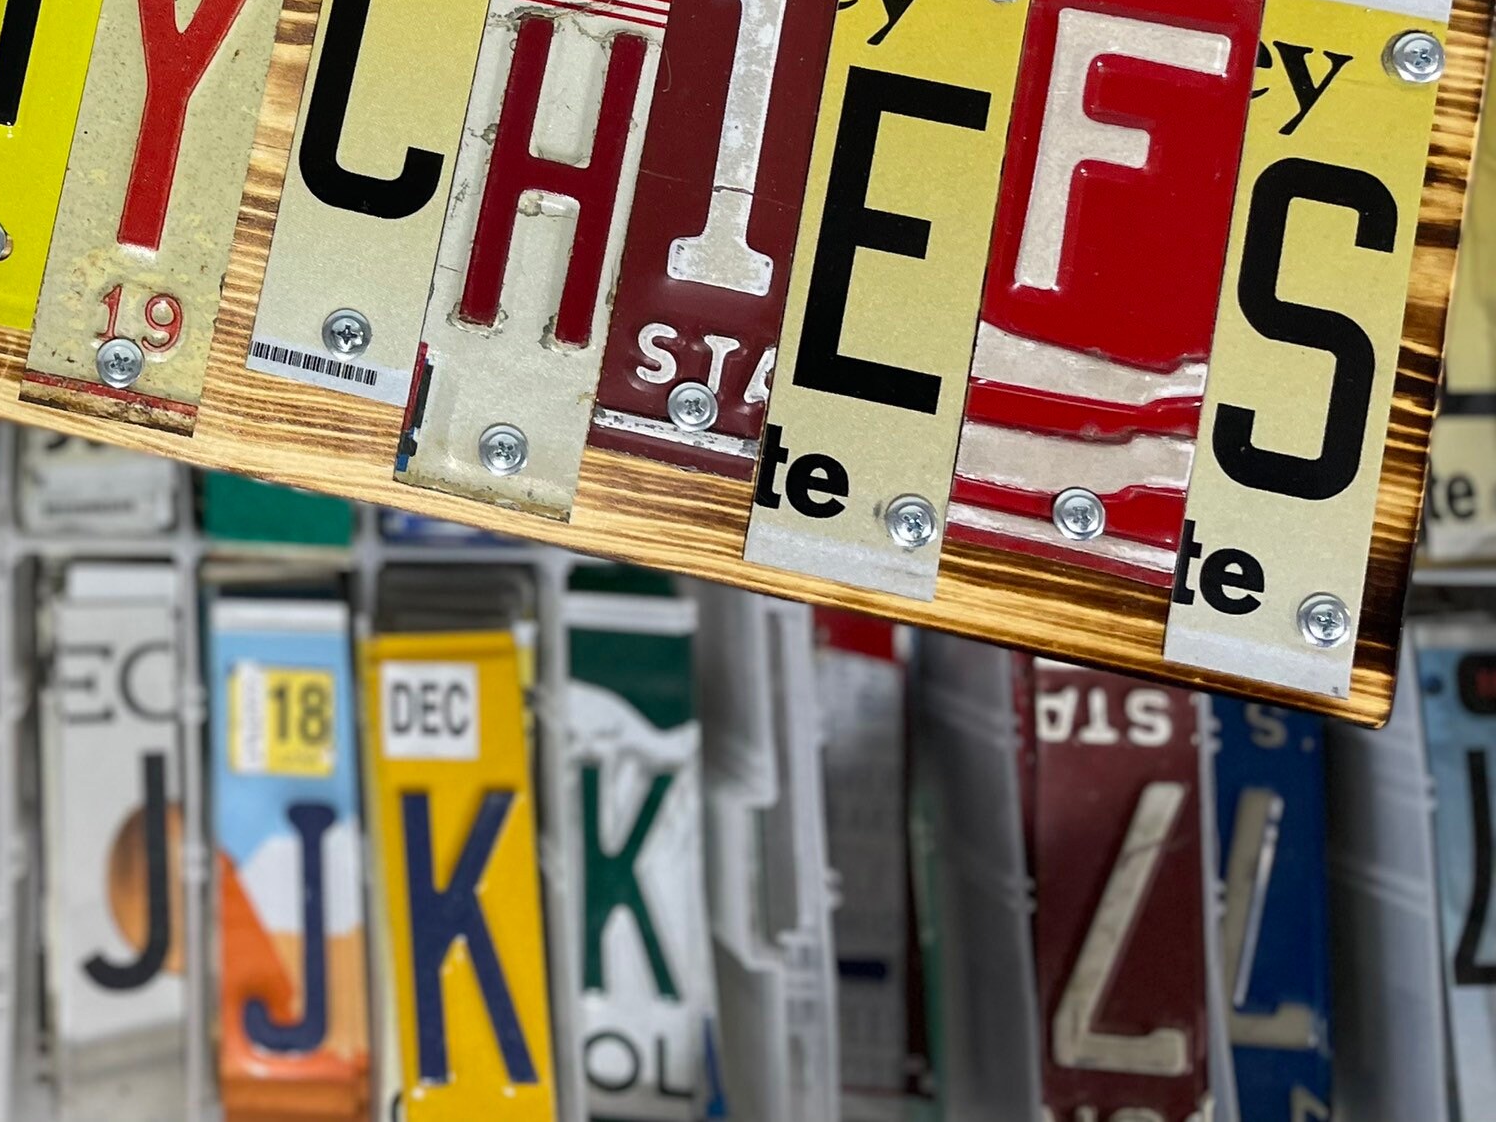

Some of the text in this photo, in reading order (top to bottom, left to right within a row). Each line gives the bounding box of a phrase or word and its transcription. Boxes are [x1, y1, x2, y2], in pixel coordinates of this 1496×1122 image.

[97, 282, 185, 356] 19
[267, 680, 330, 748] 18
[388, 679, 471, 738] DEC
[78, 751, 168, 992] J
[242, 800, 338, 1055] J
[397, 786, 540, 1086] K
[581, 764, 681, 1000] K
[580, 1031, 696, 1100] OL
